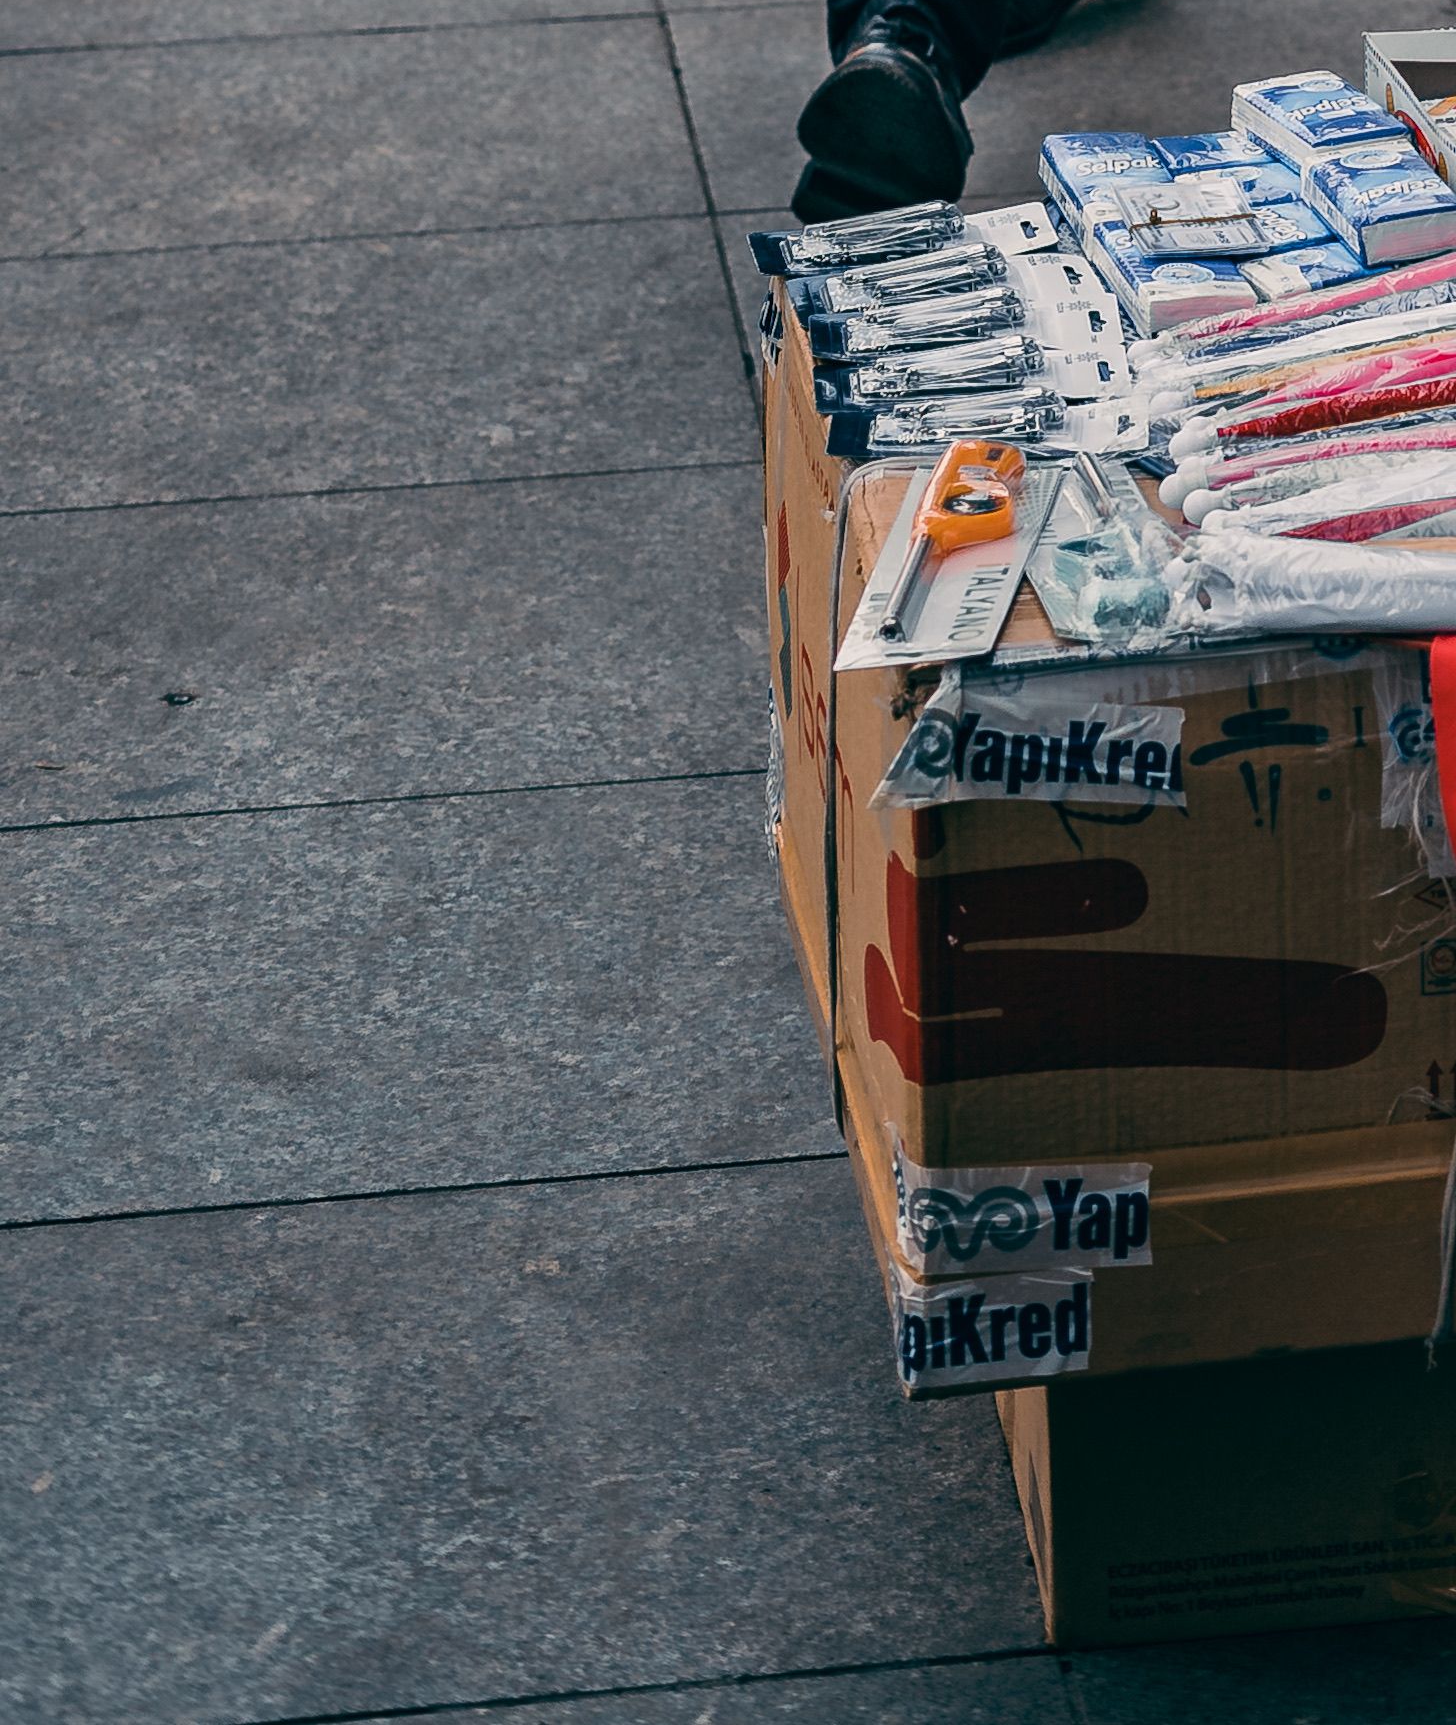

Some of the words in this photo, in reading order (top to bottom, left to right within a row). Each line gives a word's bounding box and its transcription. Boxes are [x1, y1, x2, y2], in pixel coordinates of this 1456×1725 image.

[1285, 95, 1369, 124] Selpak
[1076, 154, 1163, 177] Selpak
[1352, 178, 1443, 207] Selpak
[1039, 1176, 1148, 1259] Yap
